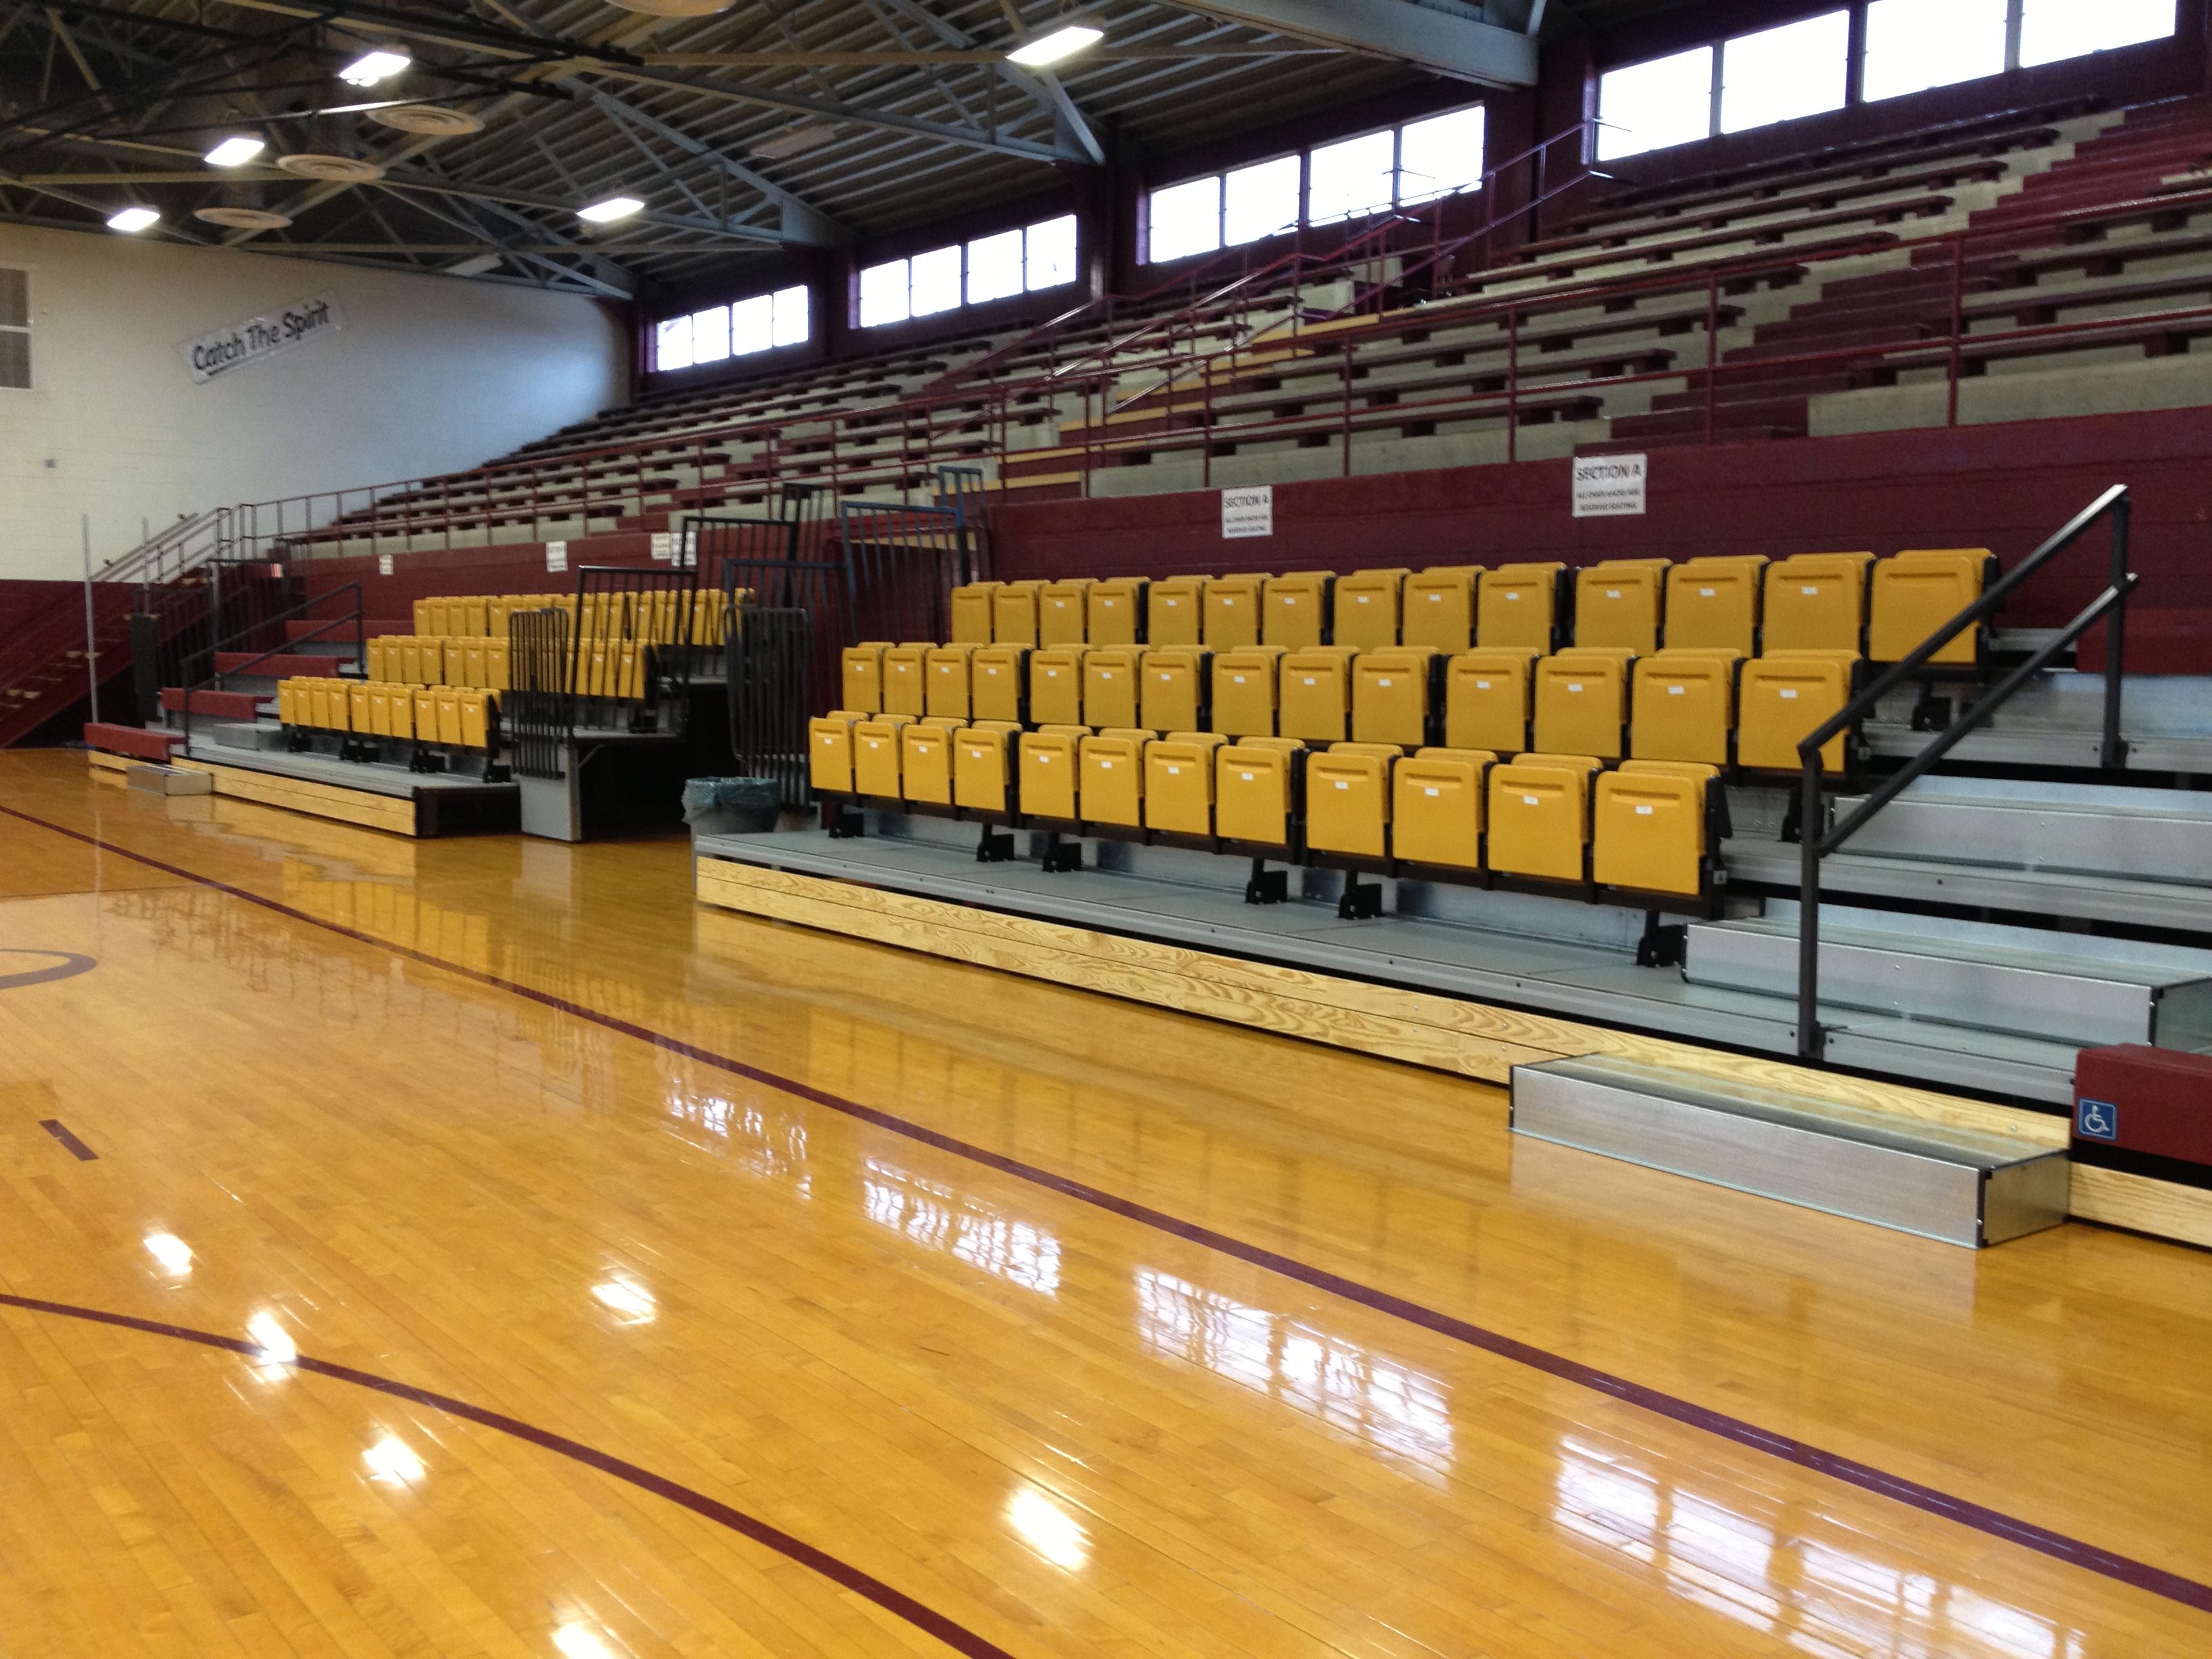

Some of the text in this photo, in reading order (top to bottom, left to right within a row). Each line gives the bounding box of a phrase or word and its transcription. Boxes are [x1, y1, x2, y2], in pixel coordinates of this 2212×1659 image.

[193, 299, 329, 369] Catch The Spirit
[1576, 463, 1642, 481] SECTION A
[1223, 495, 1260, 508] SECTION
